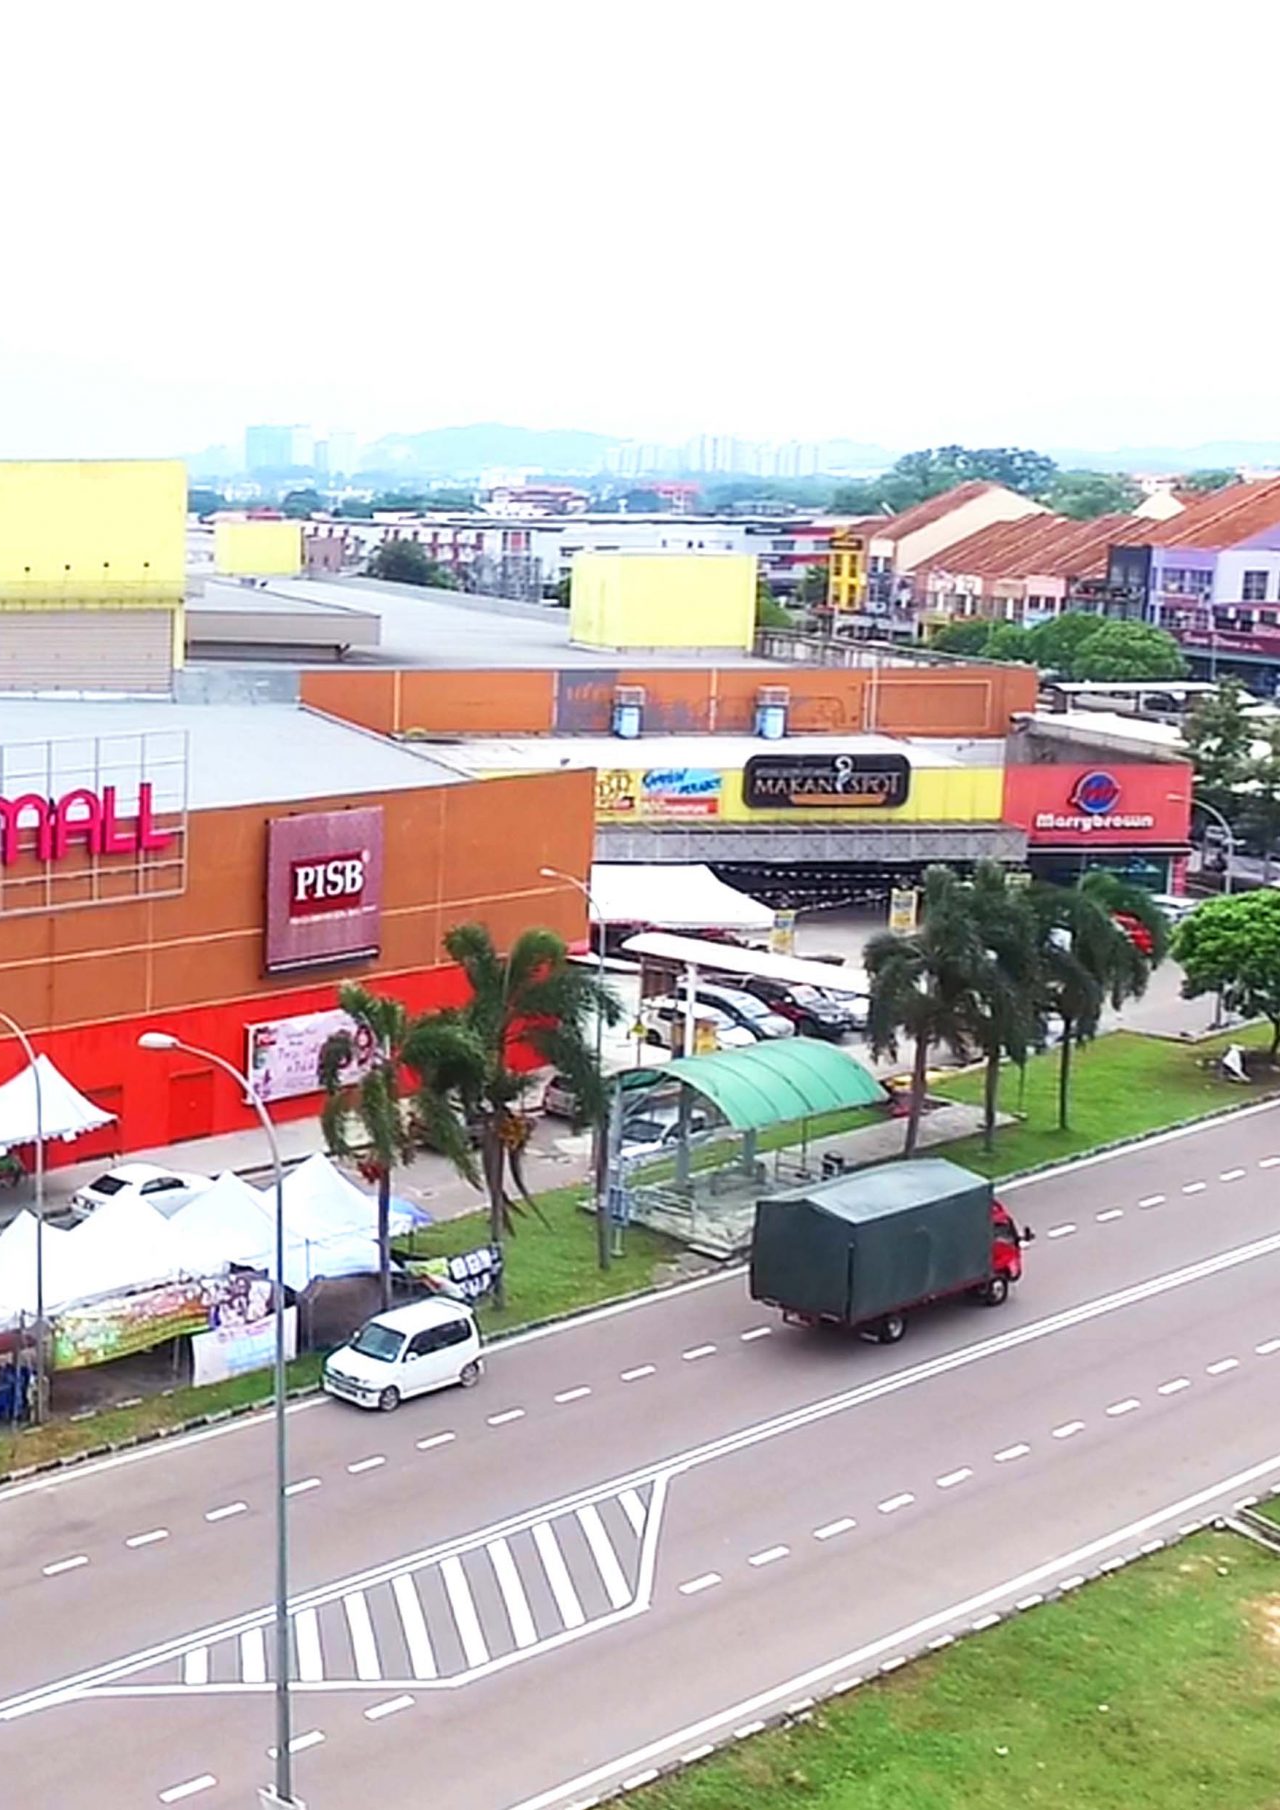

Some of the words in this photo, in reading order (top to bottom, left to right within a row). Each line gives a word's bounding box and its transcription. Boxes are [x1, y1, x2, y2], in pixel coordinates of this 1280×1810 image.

[754, 778, 833, 794] MAKAN
[1036, 813, 1154, 832] Marrybrown
[295, 860, 364, 900] PISB
